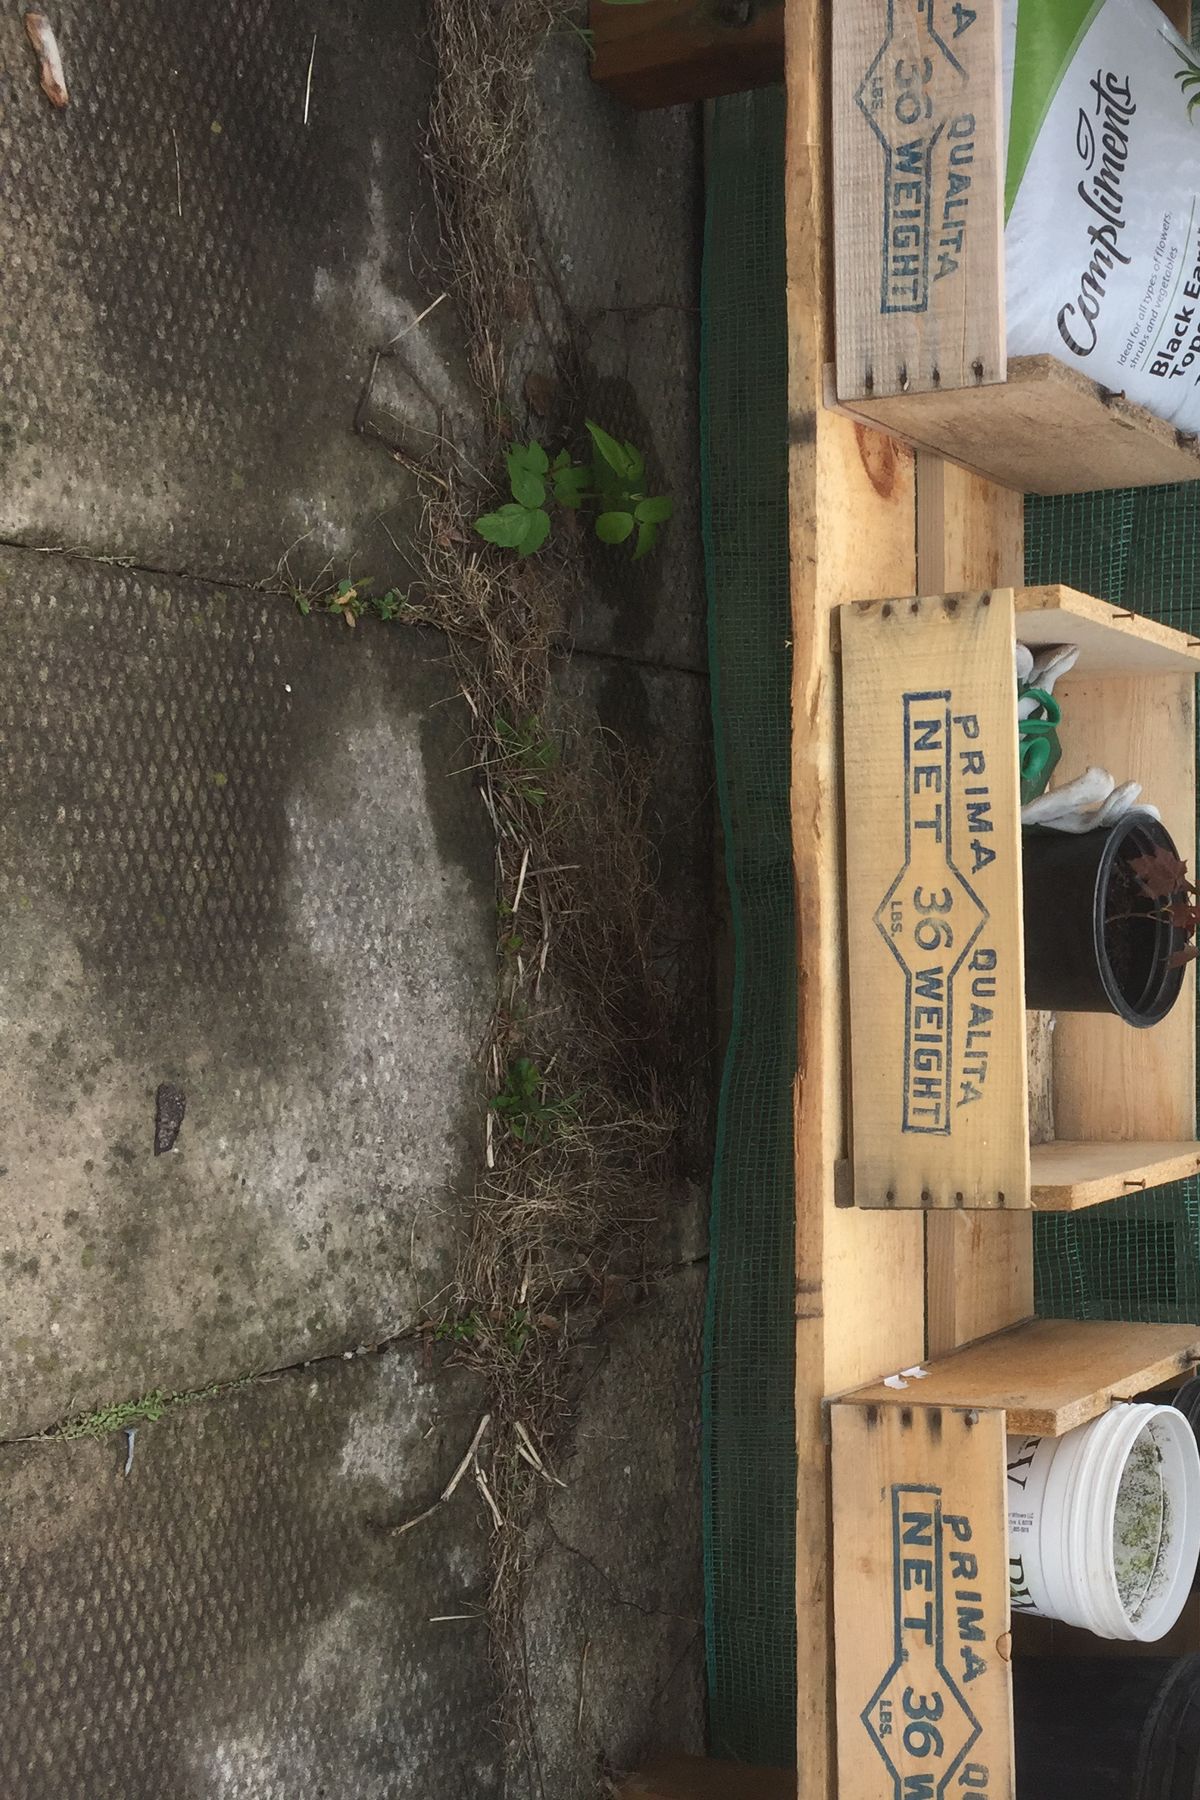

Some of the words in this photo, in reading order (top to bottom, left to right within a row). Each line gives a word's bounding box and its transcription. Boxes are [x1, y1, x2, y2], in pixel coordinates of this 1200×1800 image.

[891, 138, 924, 302] WEIGHT
[933, 113, 977, 283] QUALITA
[1057, 69, 1137, 357] Compliments
[1117, 338, 1134, 366] Ideal
[1130, 321, 1142, 339] for
[1138, 303, 1148, 321] all
[1144, 273, 1158, 304] types
[1154, 256, 1162, 272] of
[1130, 333, 1150, 369] shrubs
[1147, 310, 1159, 333] and
[1156, 246, 1178, 309] vegetables
[1149, 305, 1195, 378] Black
[913, 719, 942, 844] NET
[953, 714, 997, 875] PRIMA
[890, 901, 903, 937] LBS.
[913, 886, 953, 951] 36
[912, 966, 944, 1125] WEIGHT
[957, 948, 998, 1108] QUALITA
[902, 1512, 934, 1647] NET
[942, 1514, 987, 1683] PRIMA
[879, 1700, 893, 1739] LBS.
[902, 1686, 944, 1758] 36
